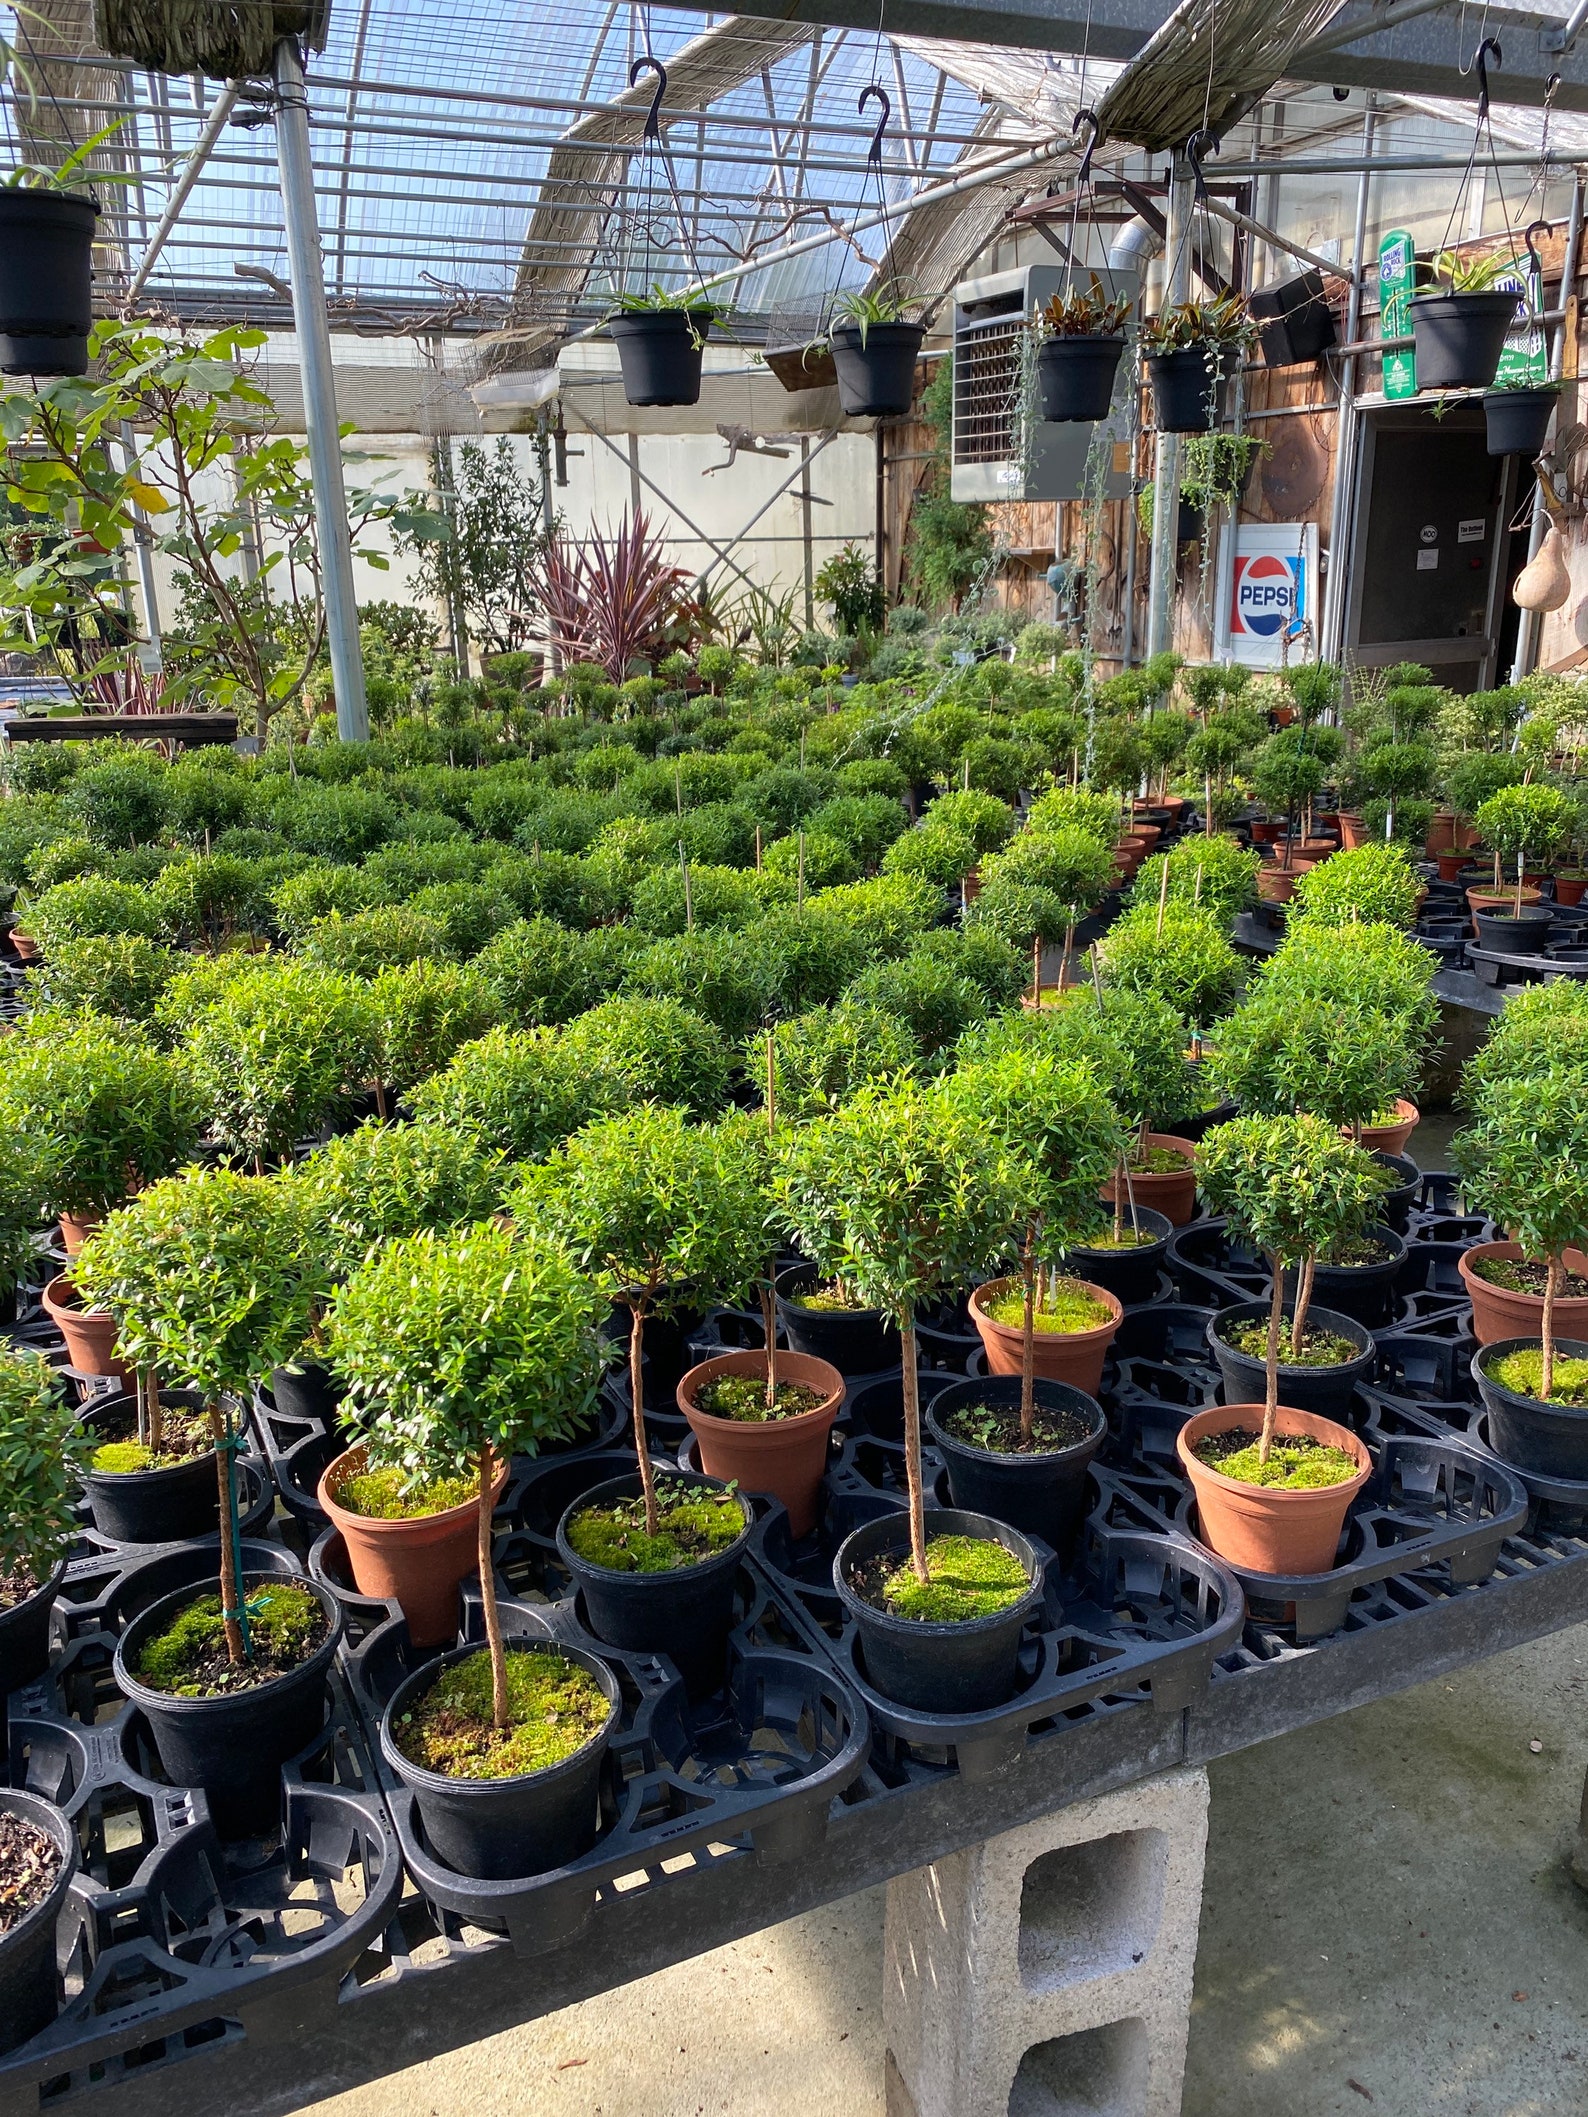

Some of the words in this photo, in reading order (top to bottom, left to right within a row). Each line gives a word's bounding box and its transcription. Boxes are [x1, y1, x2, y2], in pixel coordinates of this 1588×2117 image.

[1383, 247, 1401, 262] ROLLING
[1391, 257, 1402, 265] ROCK
[1240, 585, 1294, 607] PEPSI
